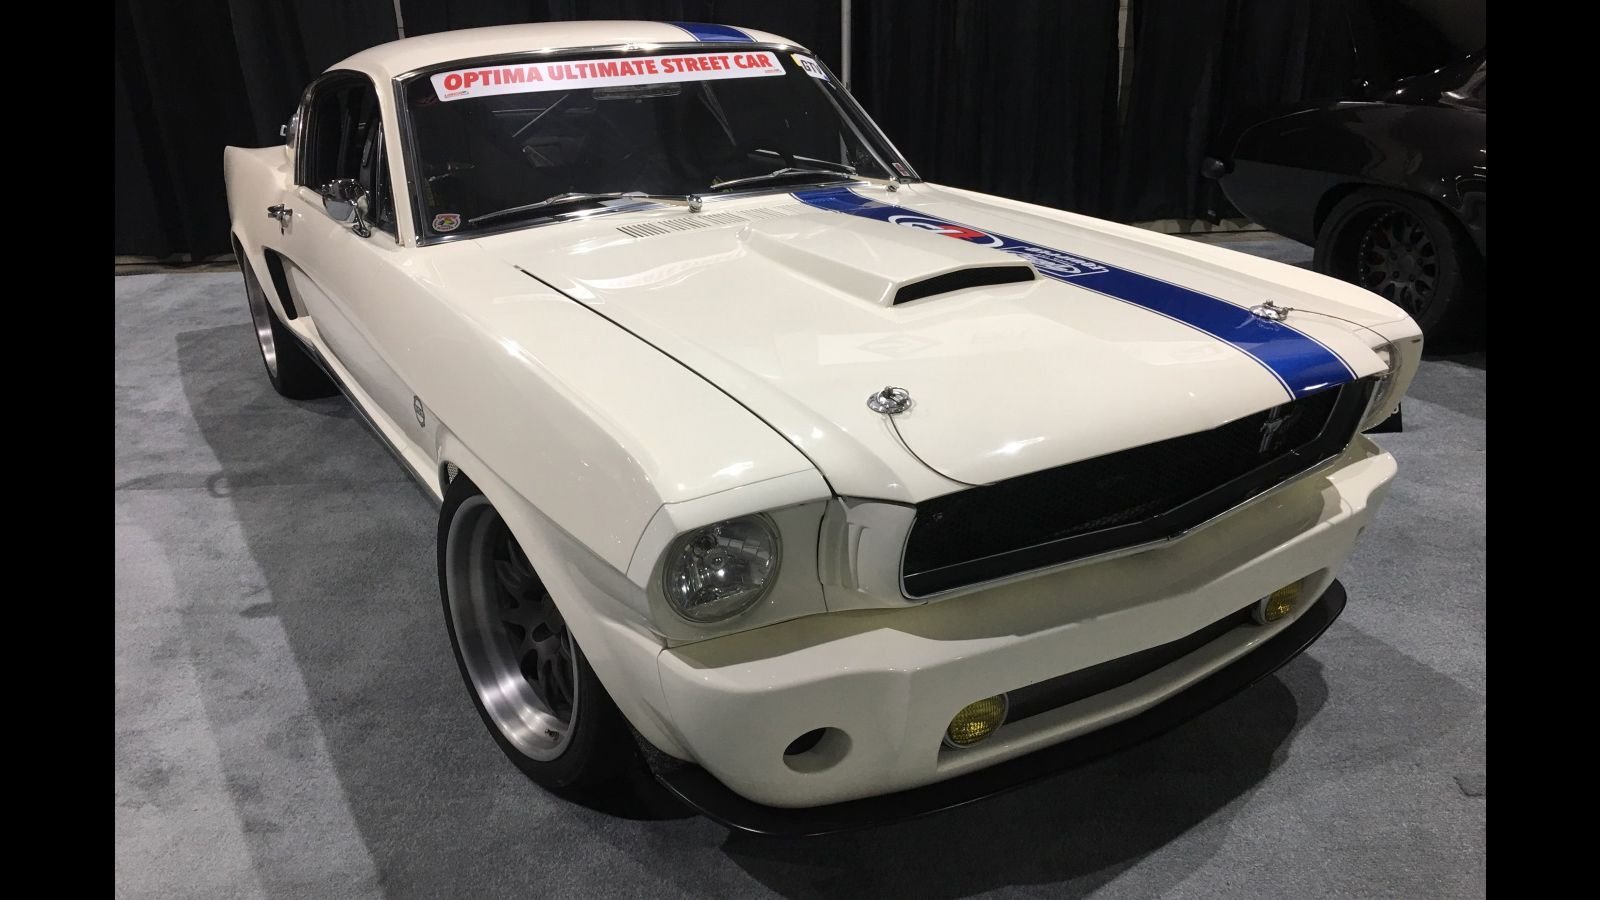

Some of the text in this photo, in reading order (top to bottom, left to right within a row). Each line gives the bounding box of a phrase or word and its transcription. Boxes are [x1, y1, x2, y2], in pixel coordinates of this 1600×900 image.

[444, 53, 772, 91] OPTIMA ULTIMATE STREET CAR
